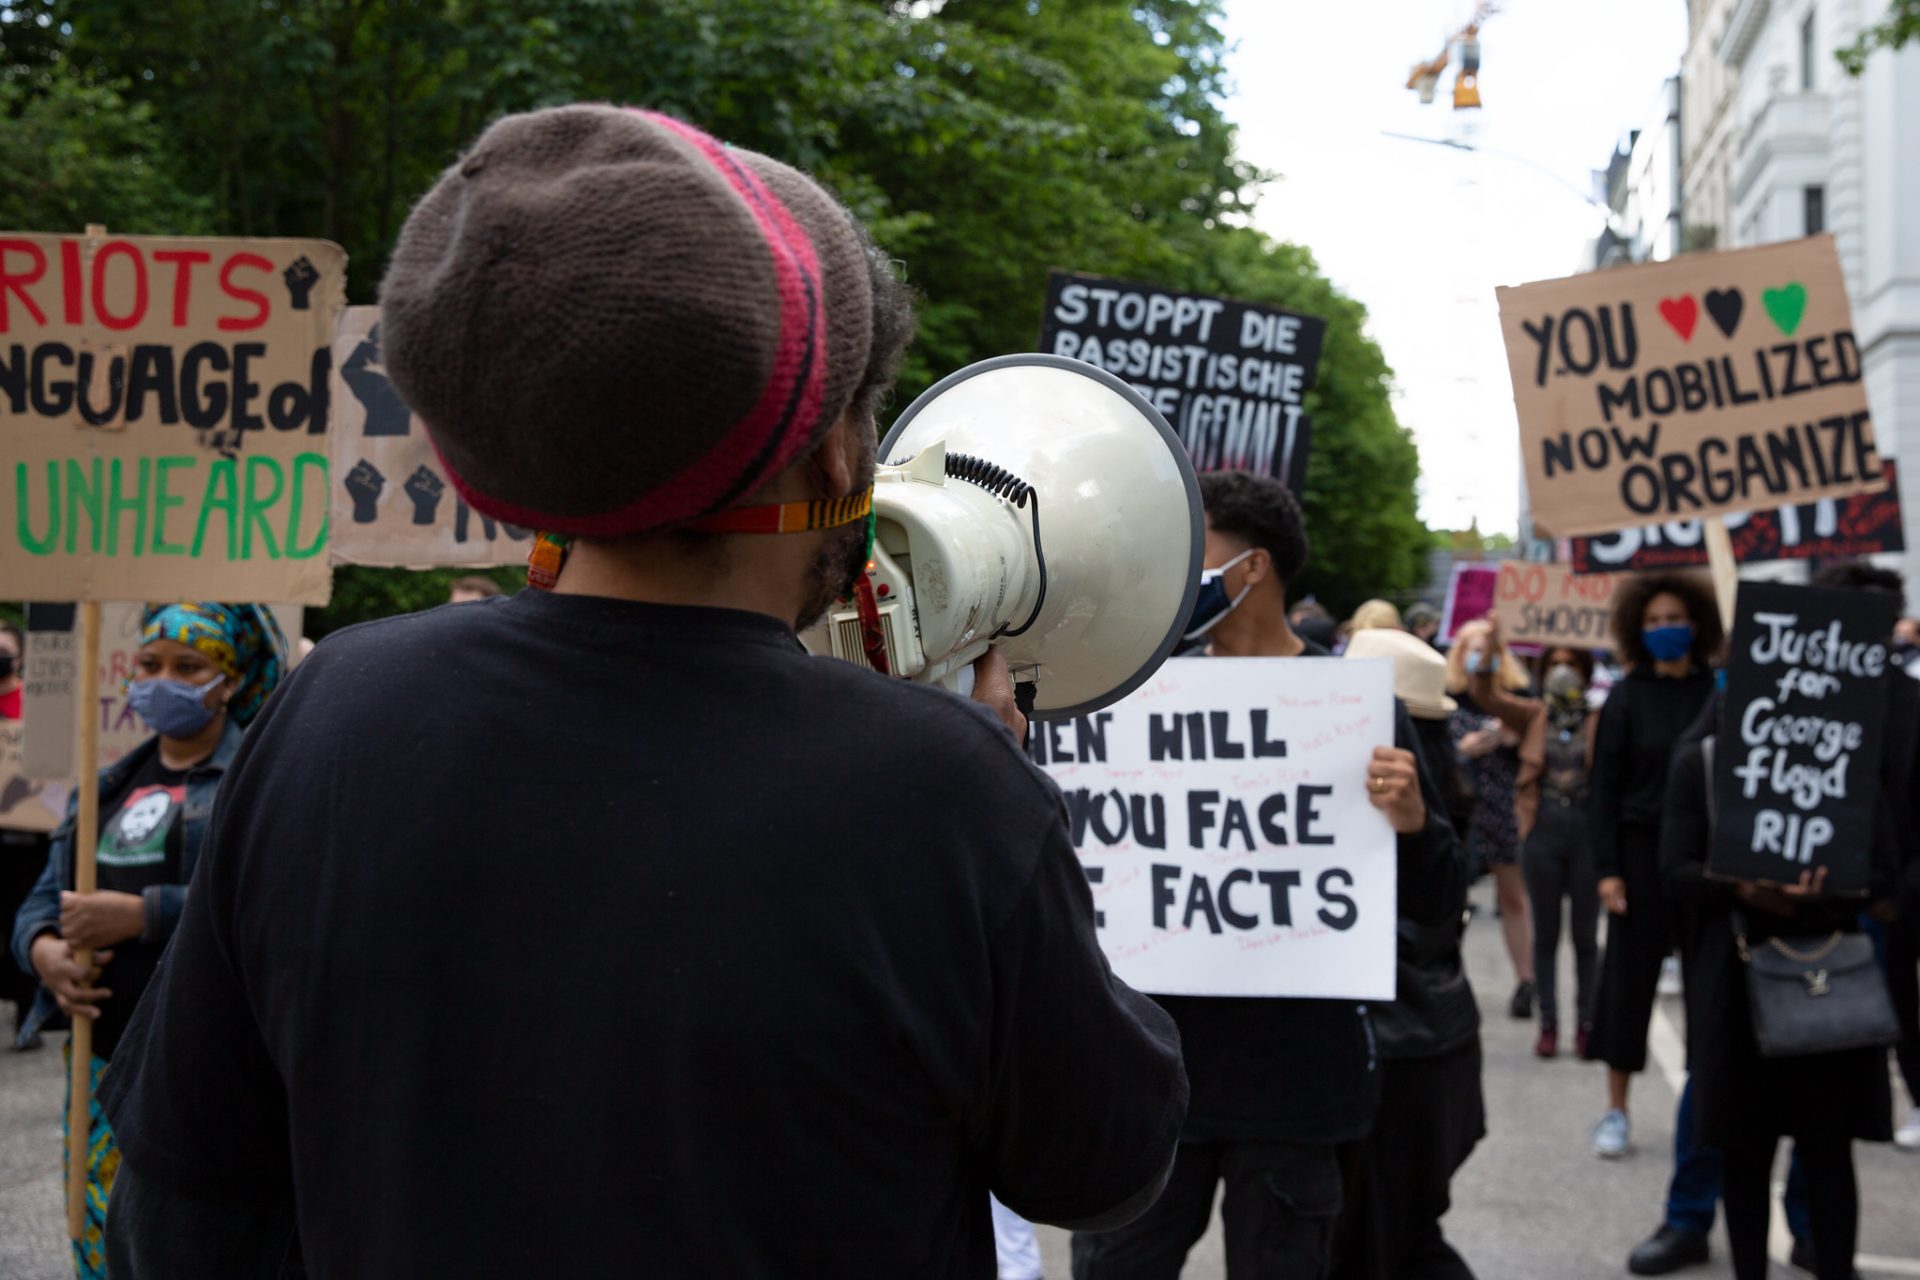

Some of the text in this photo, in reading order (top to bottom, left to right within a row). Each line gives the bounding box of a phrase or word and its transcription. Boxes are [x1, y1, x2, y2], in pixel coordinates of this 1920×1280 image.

[0, 237, 275, 333] RIOTS
[1054, 284, 1303, 355] STOPPT DIE
[1522, 302, 1638, 388] YOU
[1053, 330, 1305, 403] RASSISTISCHE
[1597, 331, 1862, 421] MOBILIZED
[1541, 423, 1660, 478] NOW
[1620, 410, 1882, 515] ORGANIZE
[16, 453, 330, 561] UNHEARD
[1499, 565, 1615, 604] DO NO
[1511, 603, 1609, 638] SHOOT
[1750, 612, 1886, 677] Justice
[1776, 667, 1841, 703] for
[1029, 713, 1112, 765] HEN
[1741, 697, 1863, 761] George
[1063, 784, 1335, 851] YOU FACE
[1752, 809, 1834, 863] RIP
[1151, 863, 1358, 934] FACTS
